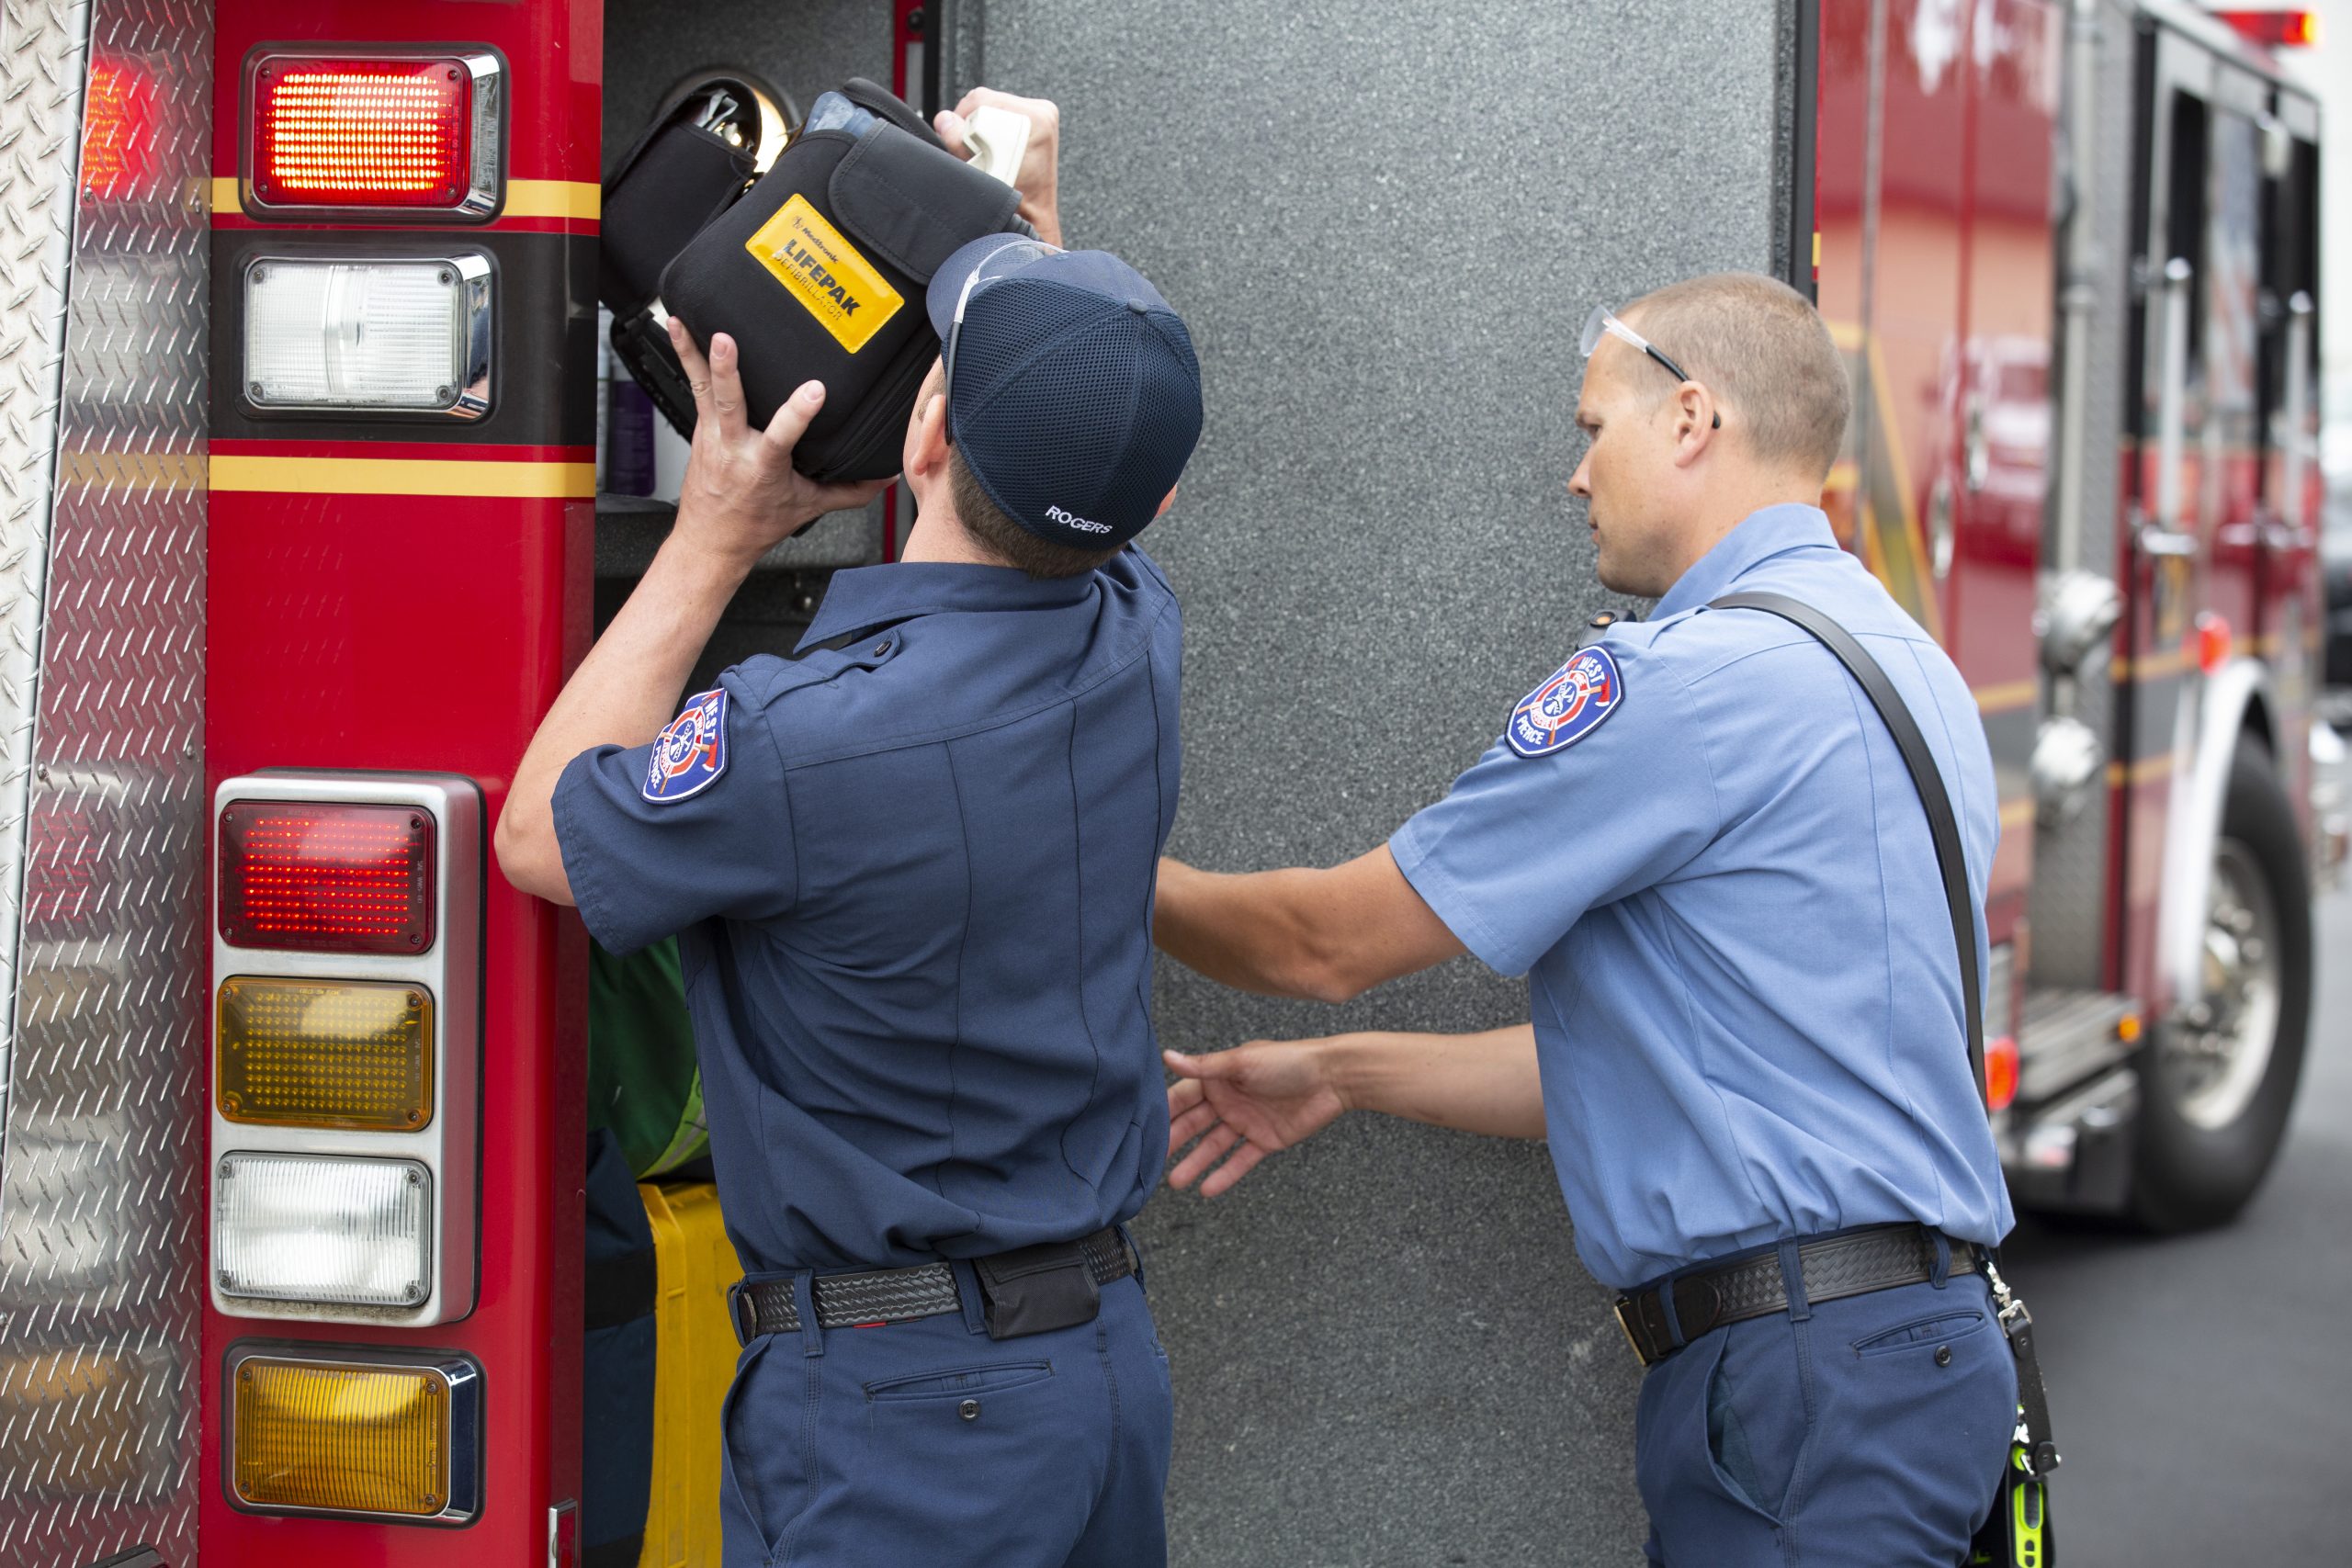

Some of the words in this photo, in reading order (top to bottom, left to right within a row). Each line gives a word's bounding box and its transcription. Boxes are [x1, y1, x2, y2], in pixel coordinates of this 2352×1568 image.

[775, 253, 842, 321] DEFIBRILLATOR
[784, 239, 861, 317] LIFEPAK
[1045, 505, 1113, 534] ROGERS
[1577, 656, 1605, 683] WEST
[704, 696, 718, 739] WEST
[1517, 715, 1544, 745] PIERCE
